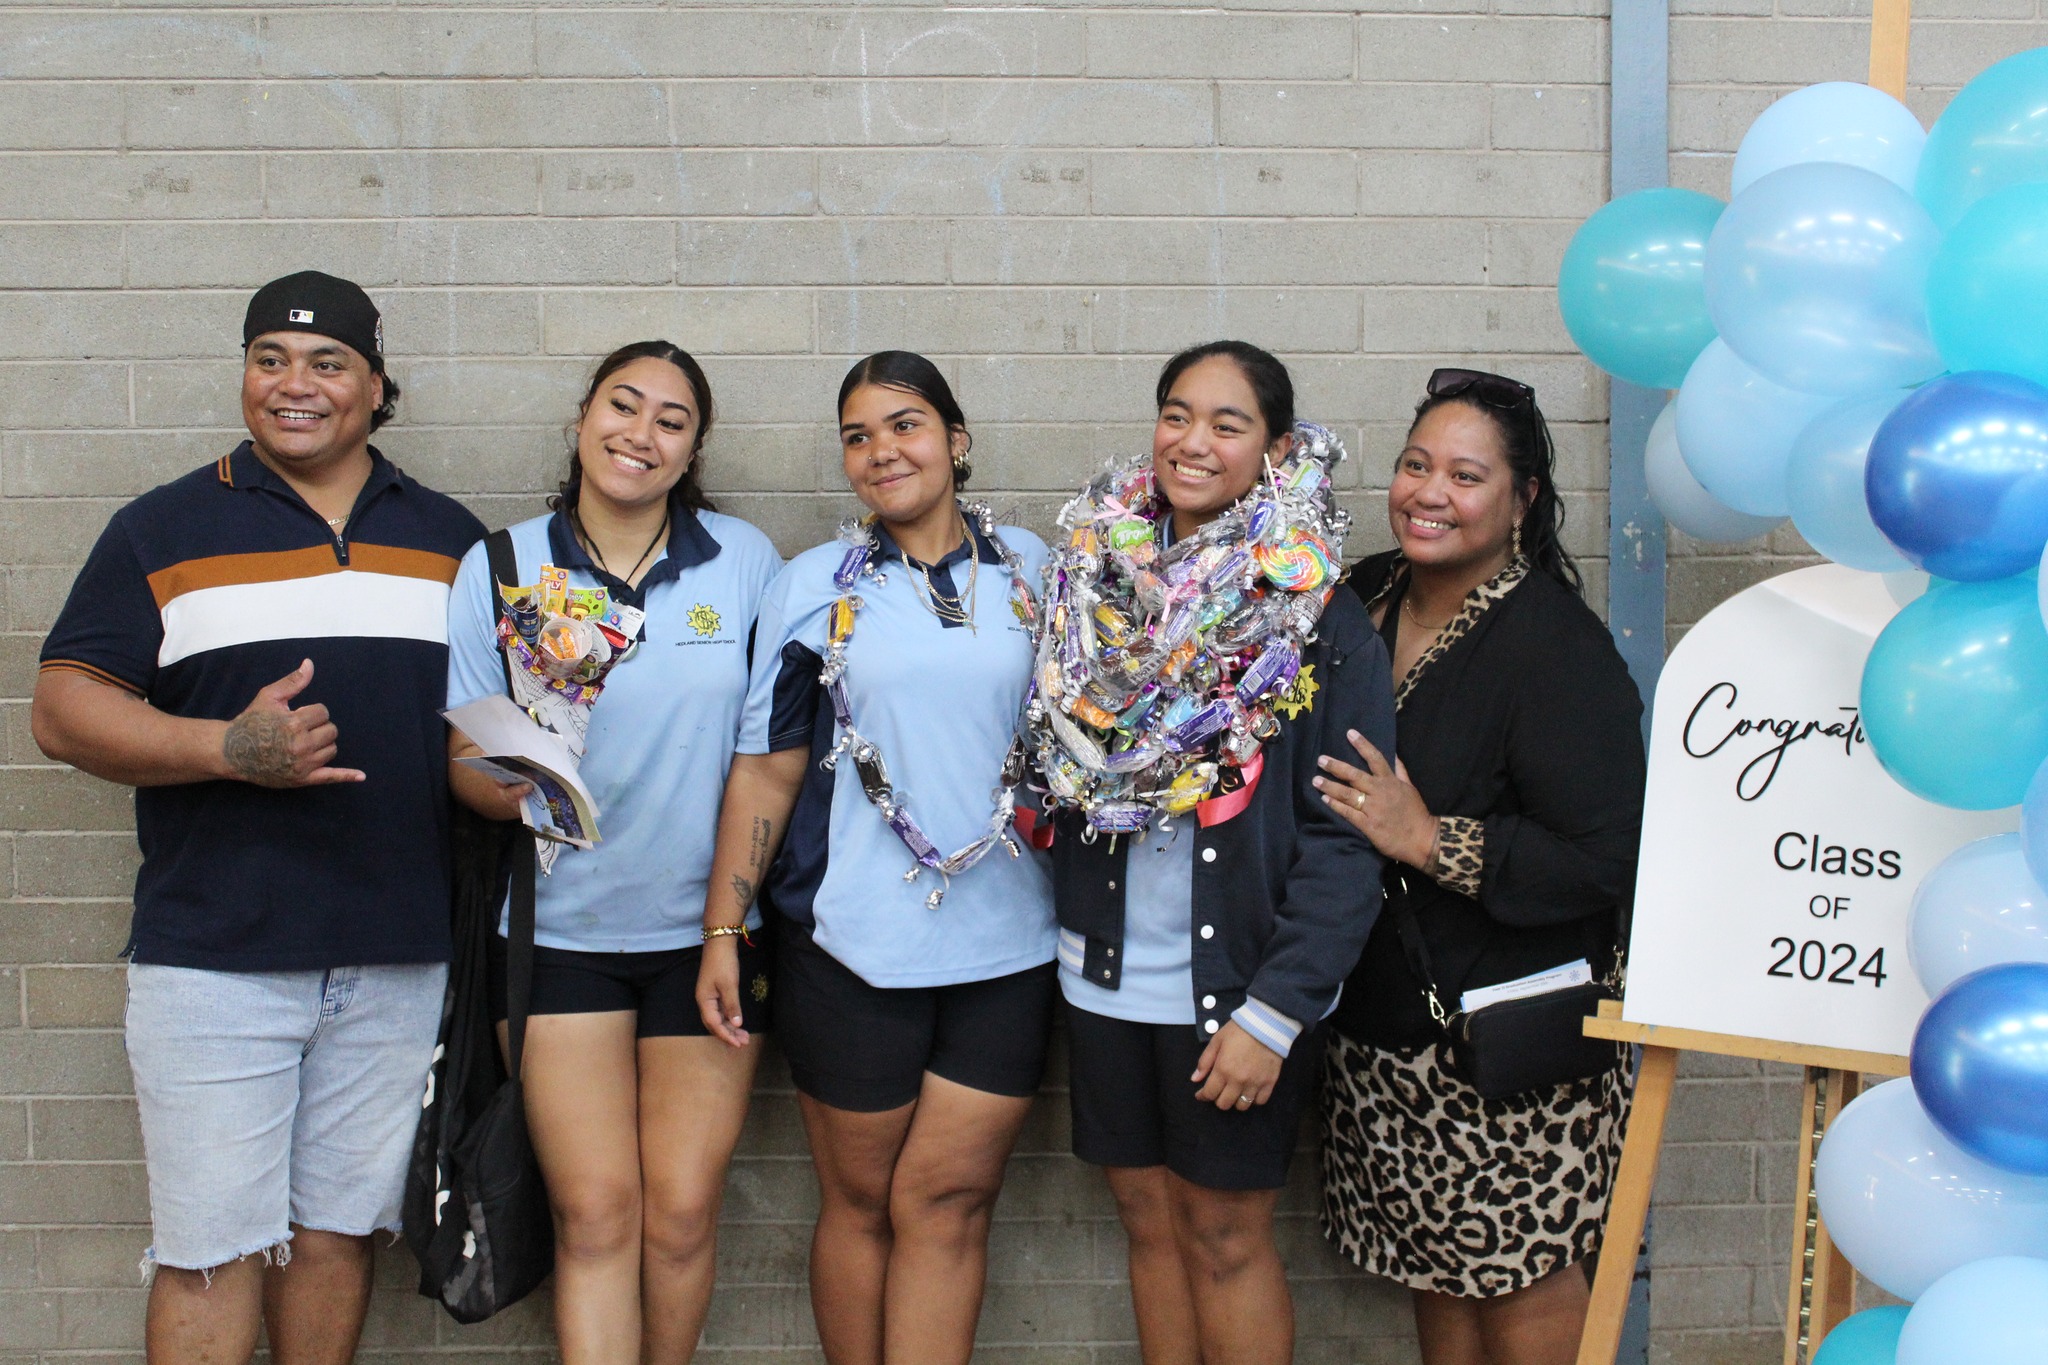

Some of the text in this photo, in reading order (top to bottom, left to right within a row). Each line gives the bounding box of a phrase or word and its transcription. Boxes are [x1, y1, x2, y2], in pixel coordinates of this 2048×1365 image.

[1774, 832, 1901, 879] Class
[1809, 895, 1851, 919] OF
[1767, 937, 1887, 988] 2024
